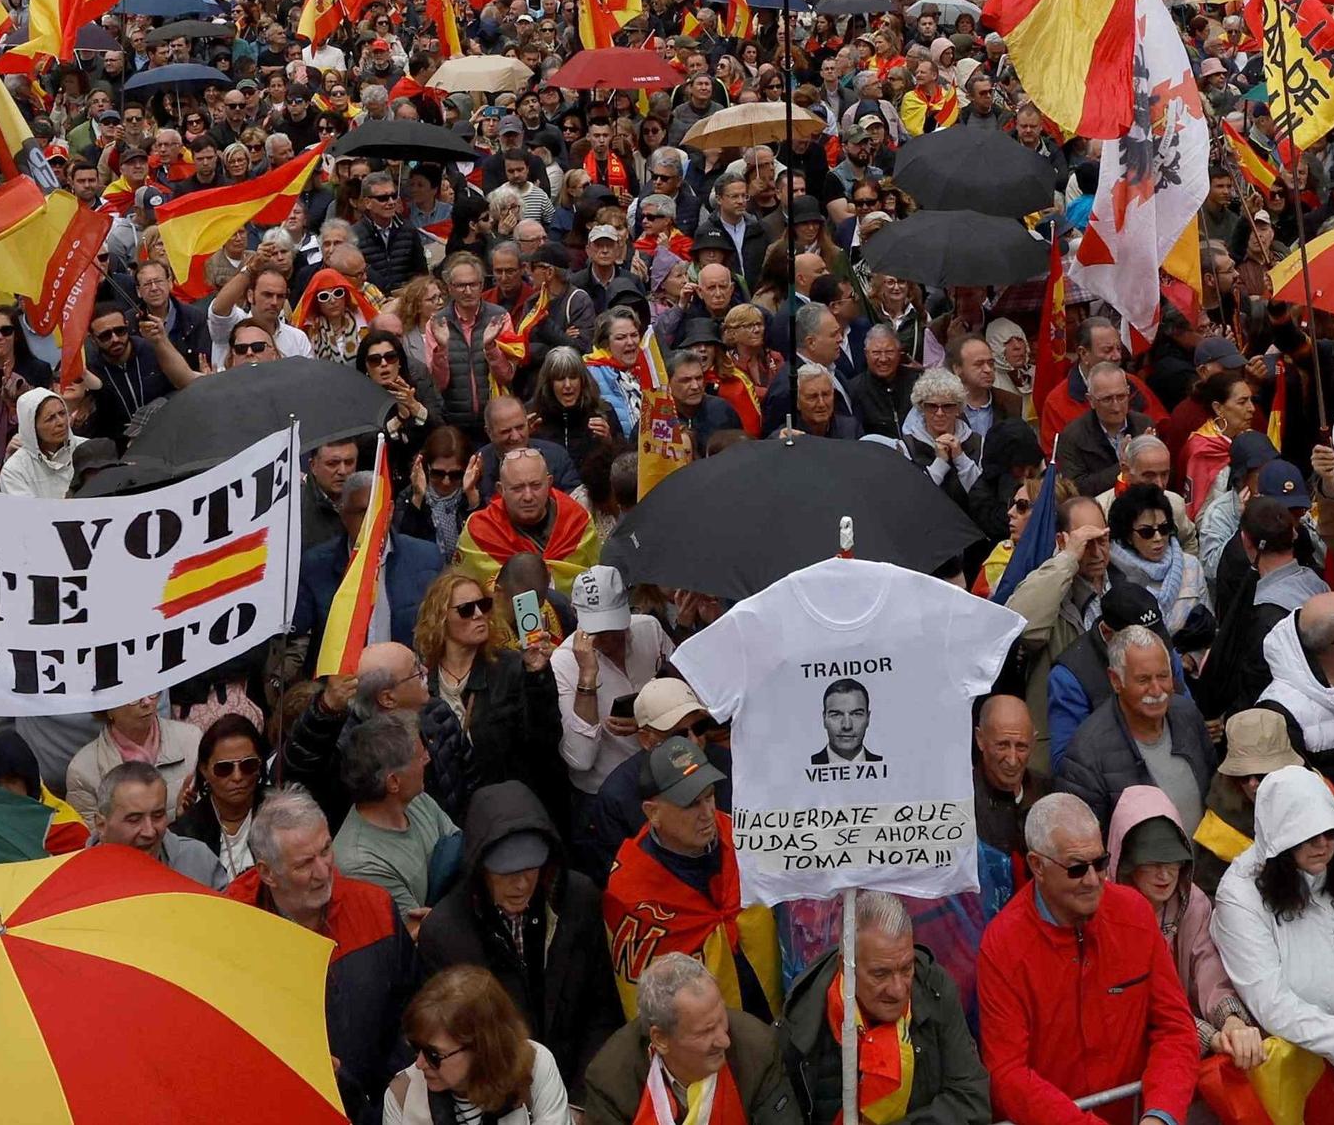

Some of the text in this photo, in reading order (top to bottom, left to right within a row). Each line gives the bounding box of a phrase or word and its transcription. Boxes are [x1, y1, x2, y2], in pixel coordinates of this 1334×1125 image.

[51, 447, 290, 571] VOTE
[581, 569, 600, 606] ESP
[801, 657, 893, 679] TRAIDOR
[805, 767, 850, 783] VETE
[894, 803, 954, 822] QUE
[734, 821, 965, 852] JUDAS SE AHORCÓ
[782, 851, 853, 871] TOMA
